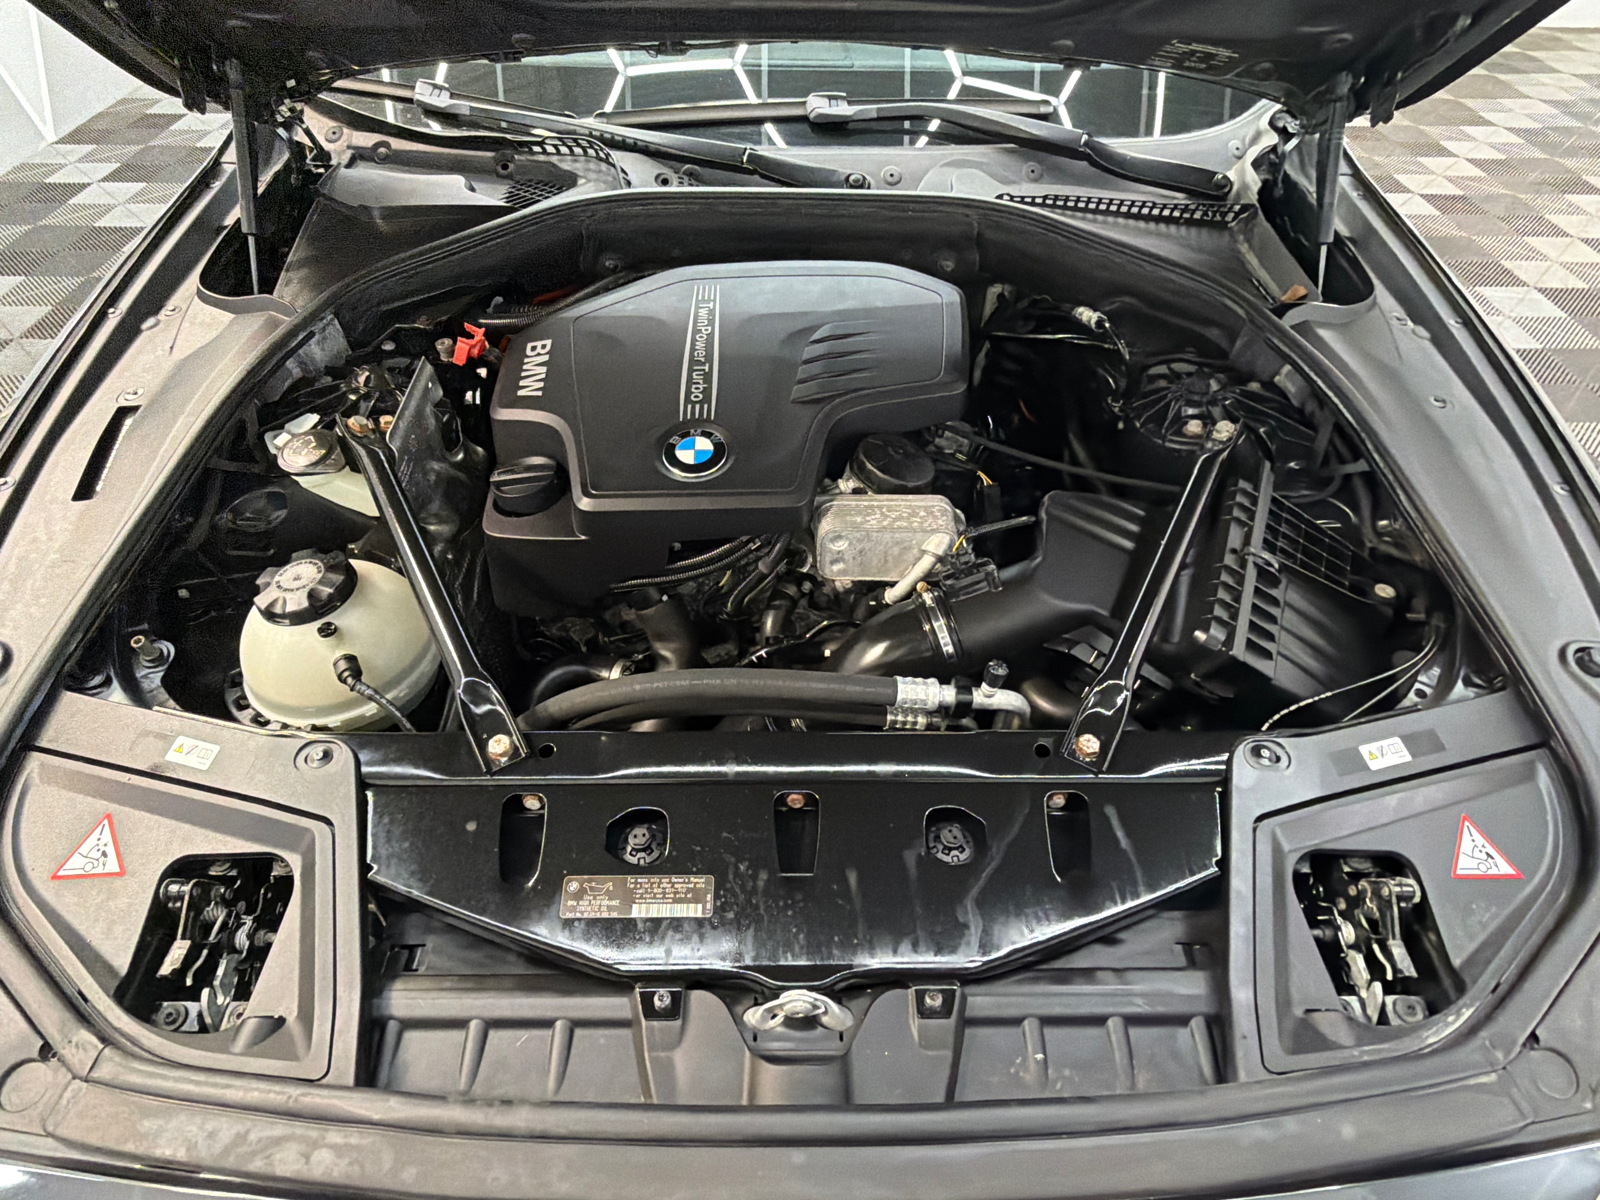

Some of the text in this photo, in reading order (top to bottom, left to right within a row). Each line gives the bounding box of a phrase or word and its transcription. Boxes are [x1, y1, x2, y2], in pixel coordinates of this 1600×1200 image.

[517, 339, 552, 396] BMW
[690, 301, 714, 402] TwinPower Turbo
[669, 429, 724, 445] BMW
